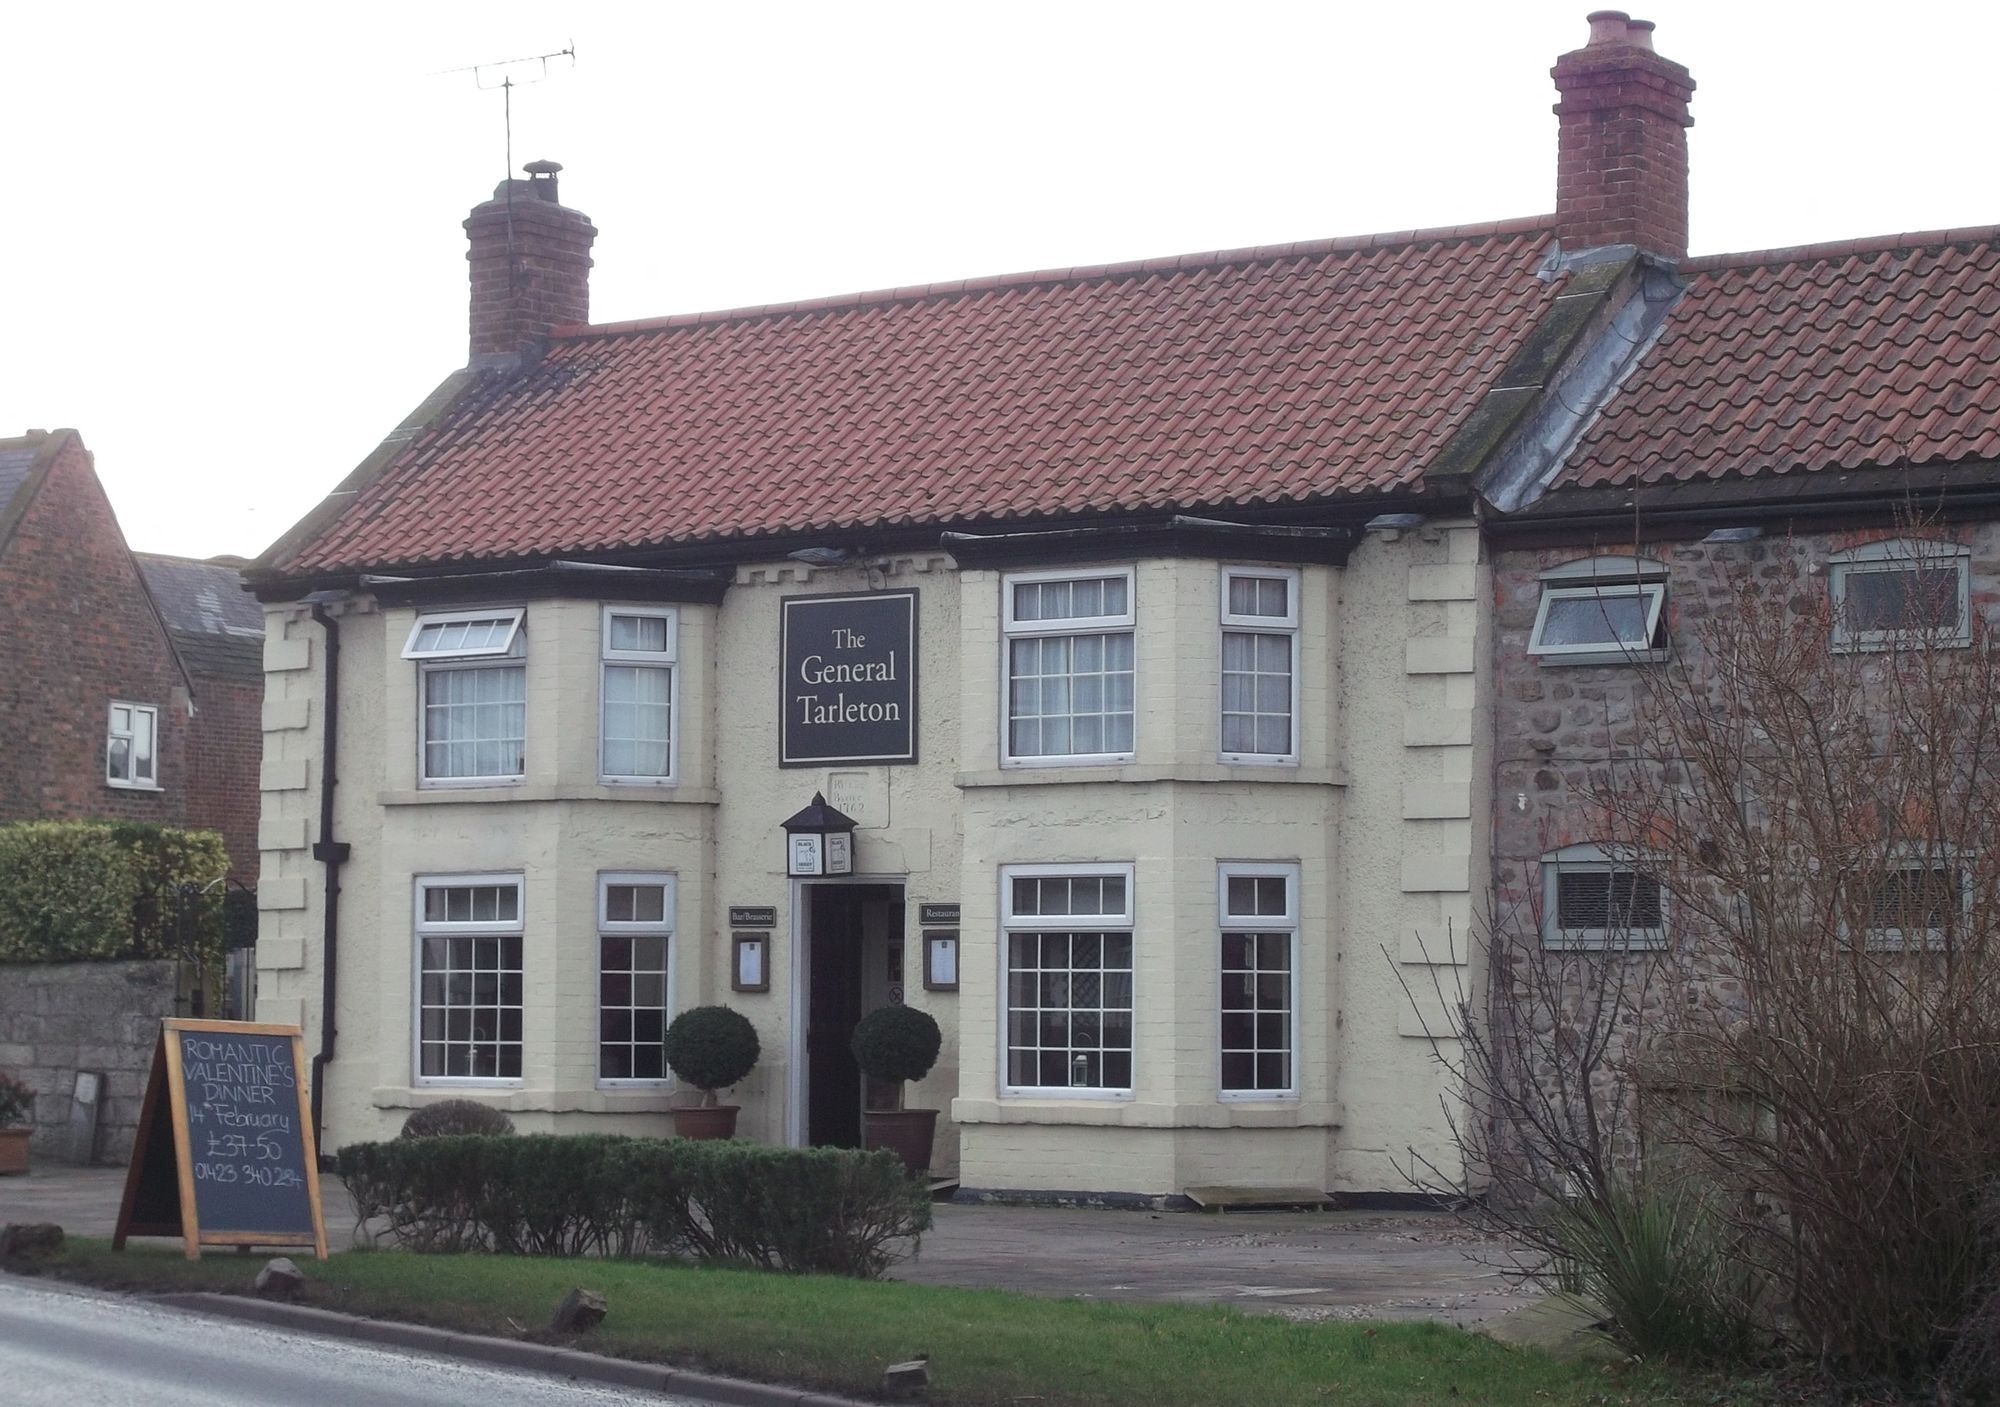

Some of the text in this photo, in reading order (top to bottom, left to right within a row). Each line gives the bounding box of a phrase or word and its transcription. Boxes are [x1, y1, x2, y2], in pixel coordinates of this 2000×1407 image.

[832, 628, 866, 649] The
[801, 650, 897, 685] General
[796, 692, 901, 724] Tarleton
[926, 908, 960, 918] Restauran
[183, 1038, 286, 1065] ROMANTIC
[182, 1062, 295, 1088] VALENTINE'S
[202, 1082, 276, 1105] DINNER
[213, 1103, 289, 1135] February
[195, 1162, 238, 1183] 01423
